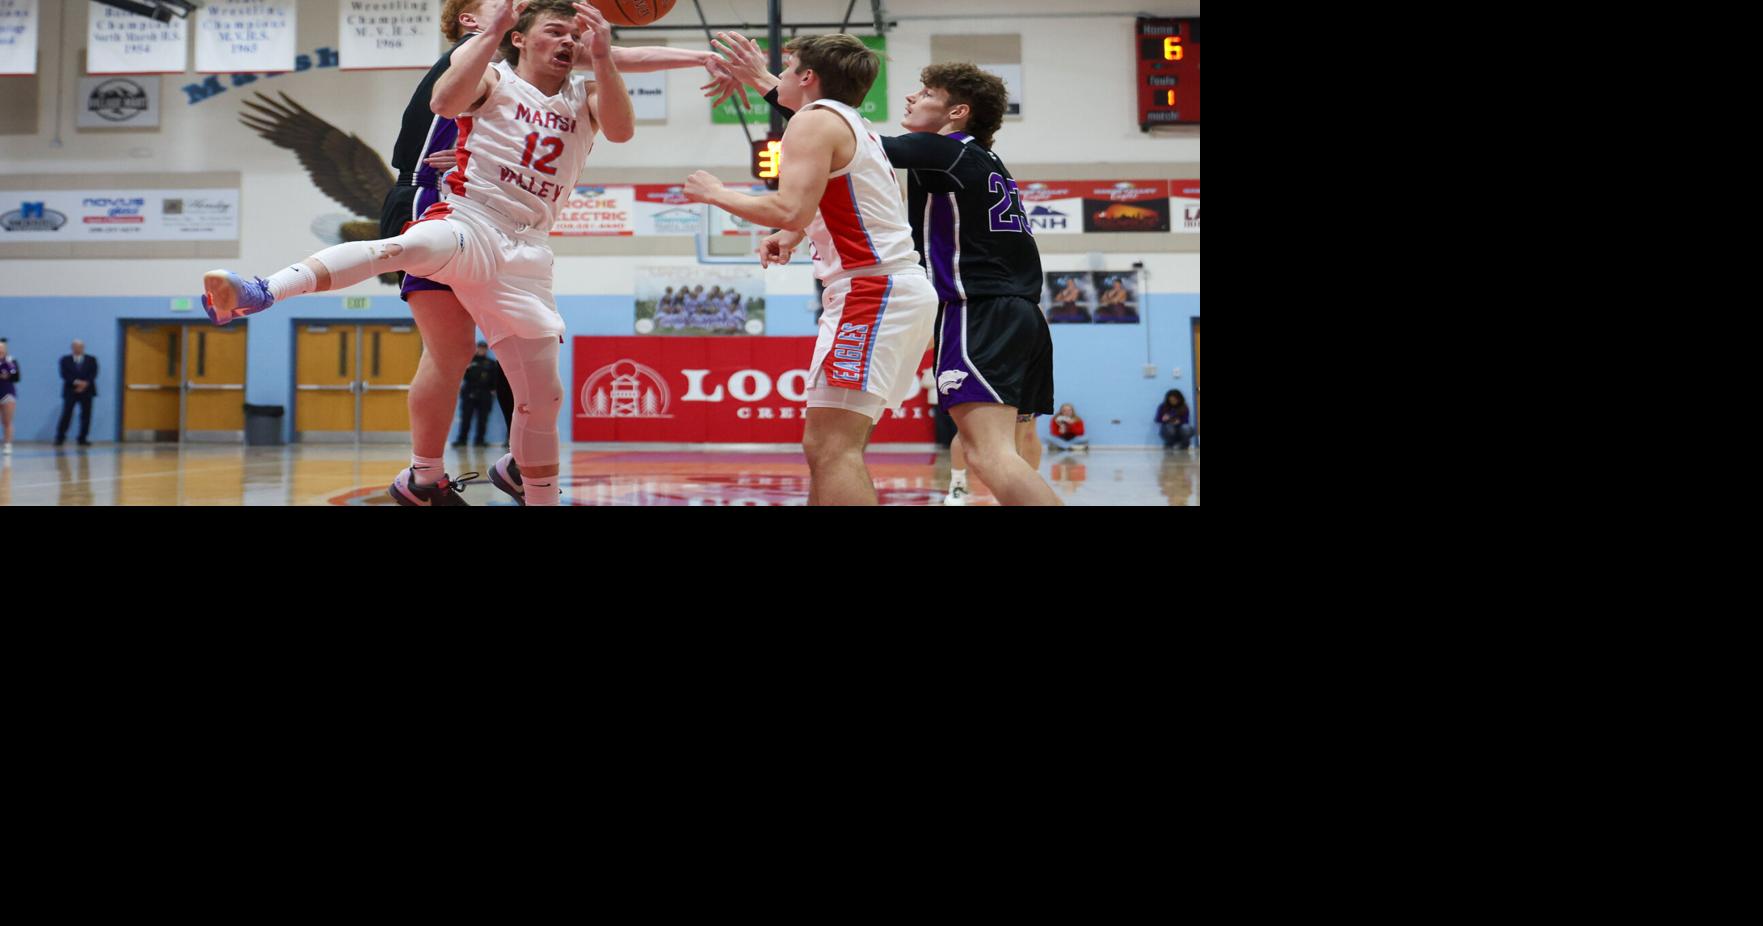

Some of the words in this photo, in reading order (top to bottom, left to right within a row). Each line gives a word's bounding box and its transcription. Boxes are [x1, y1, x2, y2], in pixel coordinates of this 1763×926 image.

[352, 2, 427, 11] Wrestling
[347, 16, 431, 25] Champions
[1164, 37, 1183, 60] 6
[1168, 89, 1175, 106] 1
[520, 132, 564, 175] 12
[499, 165, 563, 202] VALLEY
[559, 211, 627, 220] LECTRIC
[832, 322, 869, 382] EAGLES
